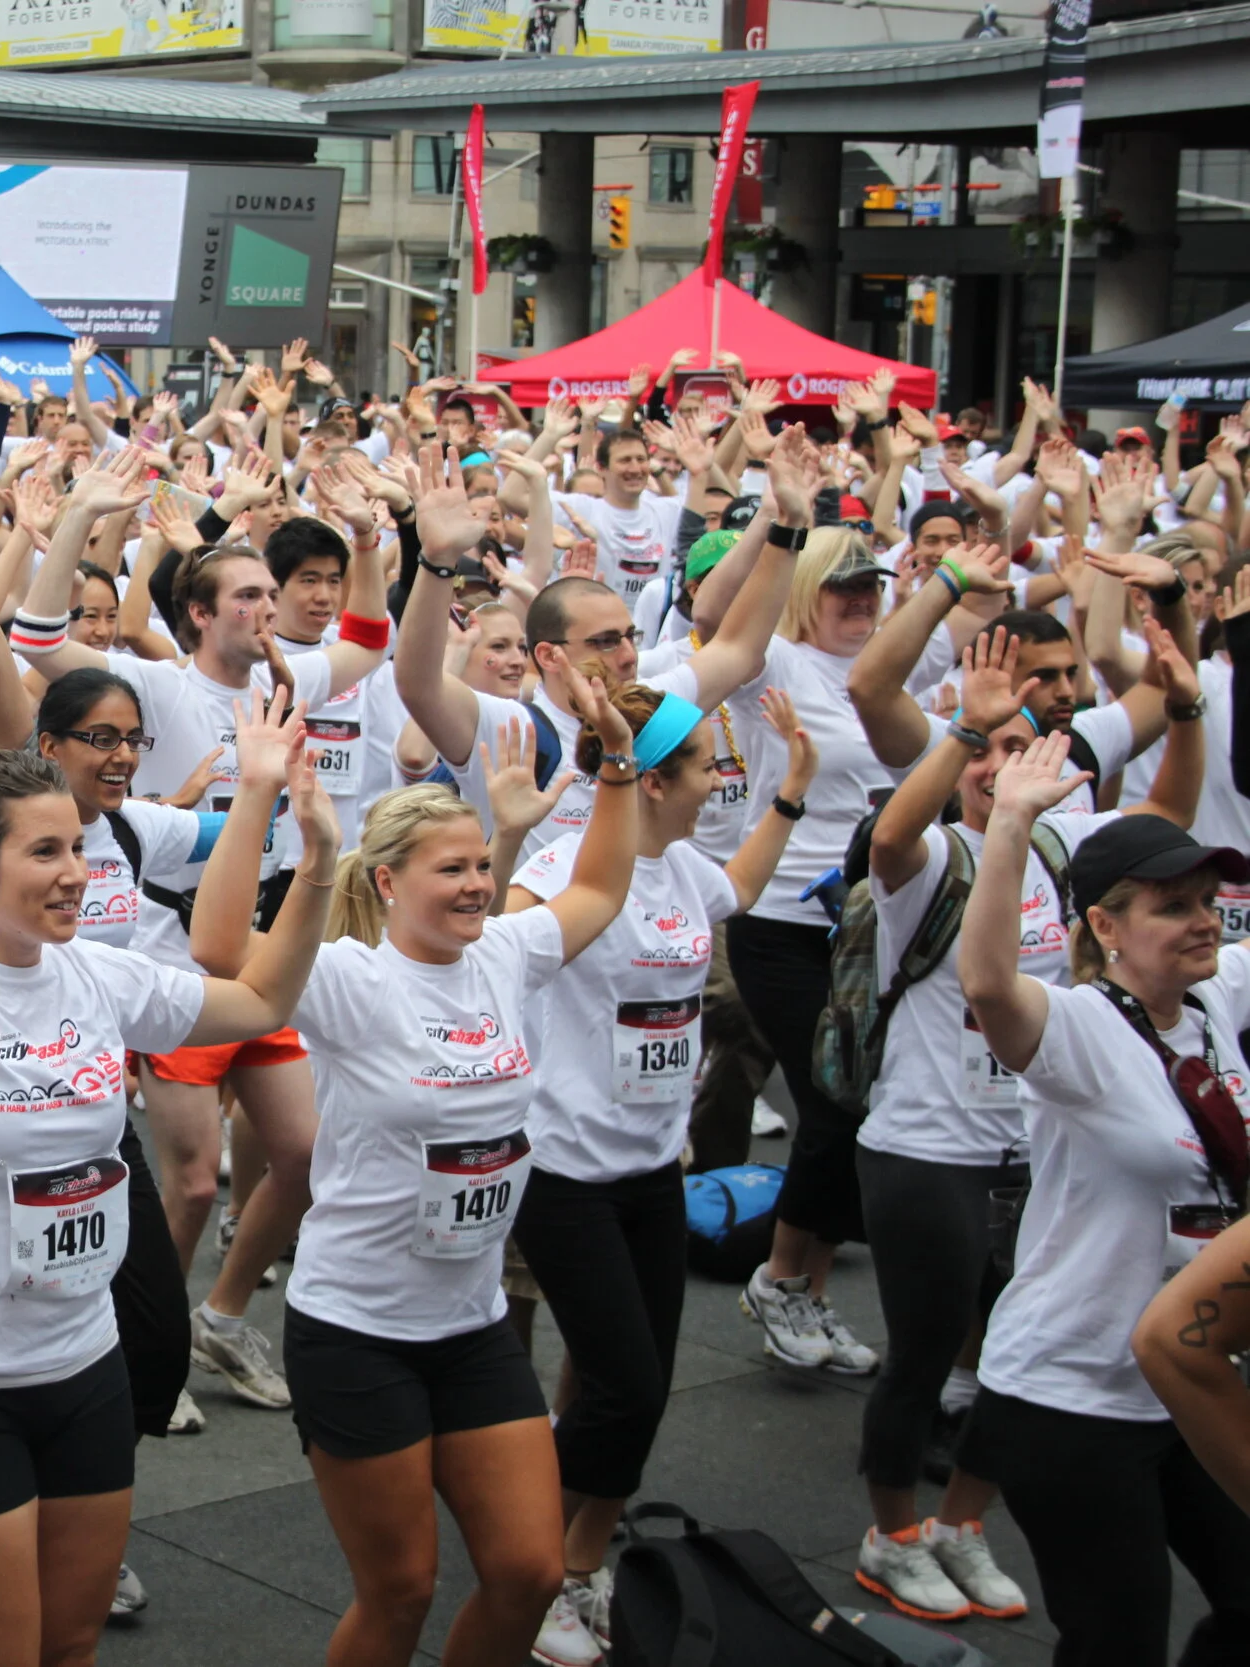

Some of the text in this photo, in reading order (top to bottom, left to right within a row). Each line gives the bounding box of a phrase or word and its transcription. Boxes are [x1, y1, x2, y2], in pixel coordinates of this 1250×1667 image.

[8, 7, 92, 25] FOREVER
[608, 5, 710, 23] FOREVER
[235, 195, 316, 213] DUNDAS
[37, 219, 112, 234] Introducing the
[35, 237, 83, 246] MOTOROLA
[199, 225, 220, 305] YONGE
[230, 286, 303, 303] SQUARE
[45, 306, 161, 321] ortable pools risky as
[93, 321, 127, 333] pools:
[128, 321, 159, 334] study
[17, 360, 95, 376] Columba
[570, 380, 631, 396] ROGERS
[1138, 377, 1175, 398] THINK
[637, 1037, 690, 1072] 1340
[95, 1050, 121, 1094] 2011
[409, 1076, 432, 1088] THINK
[30, 1103, 46, 1113] PLAY
[66, 1096, 91, 1108] LAUGH
[450, 1180, 511, 1223] 1470
[56, 1207, 77, 1219] KAYLA
[81, 1202, 96, 1215] KELLY
[42, 1210, 106, 1261] 1470
